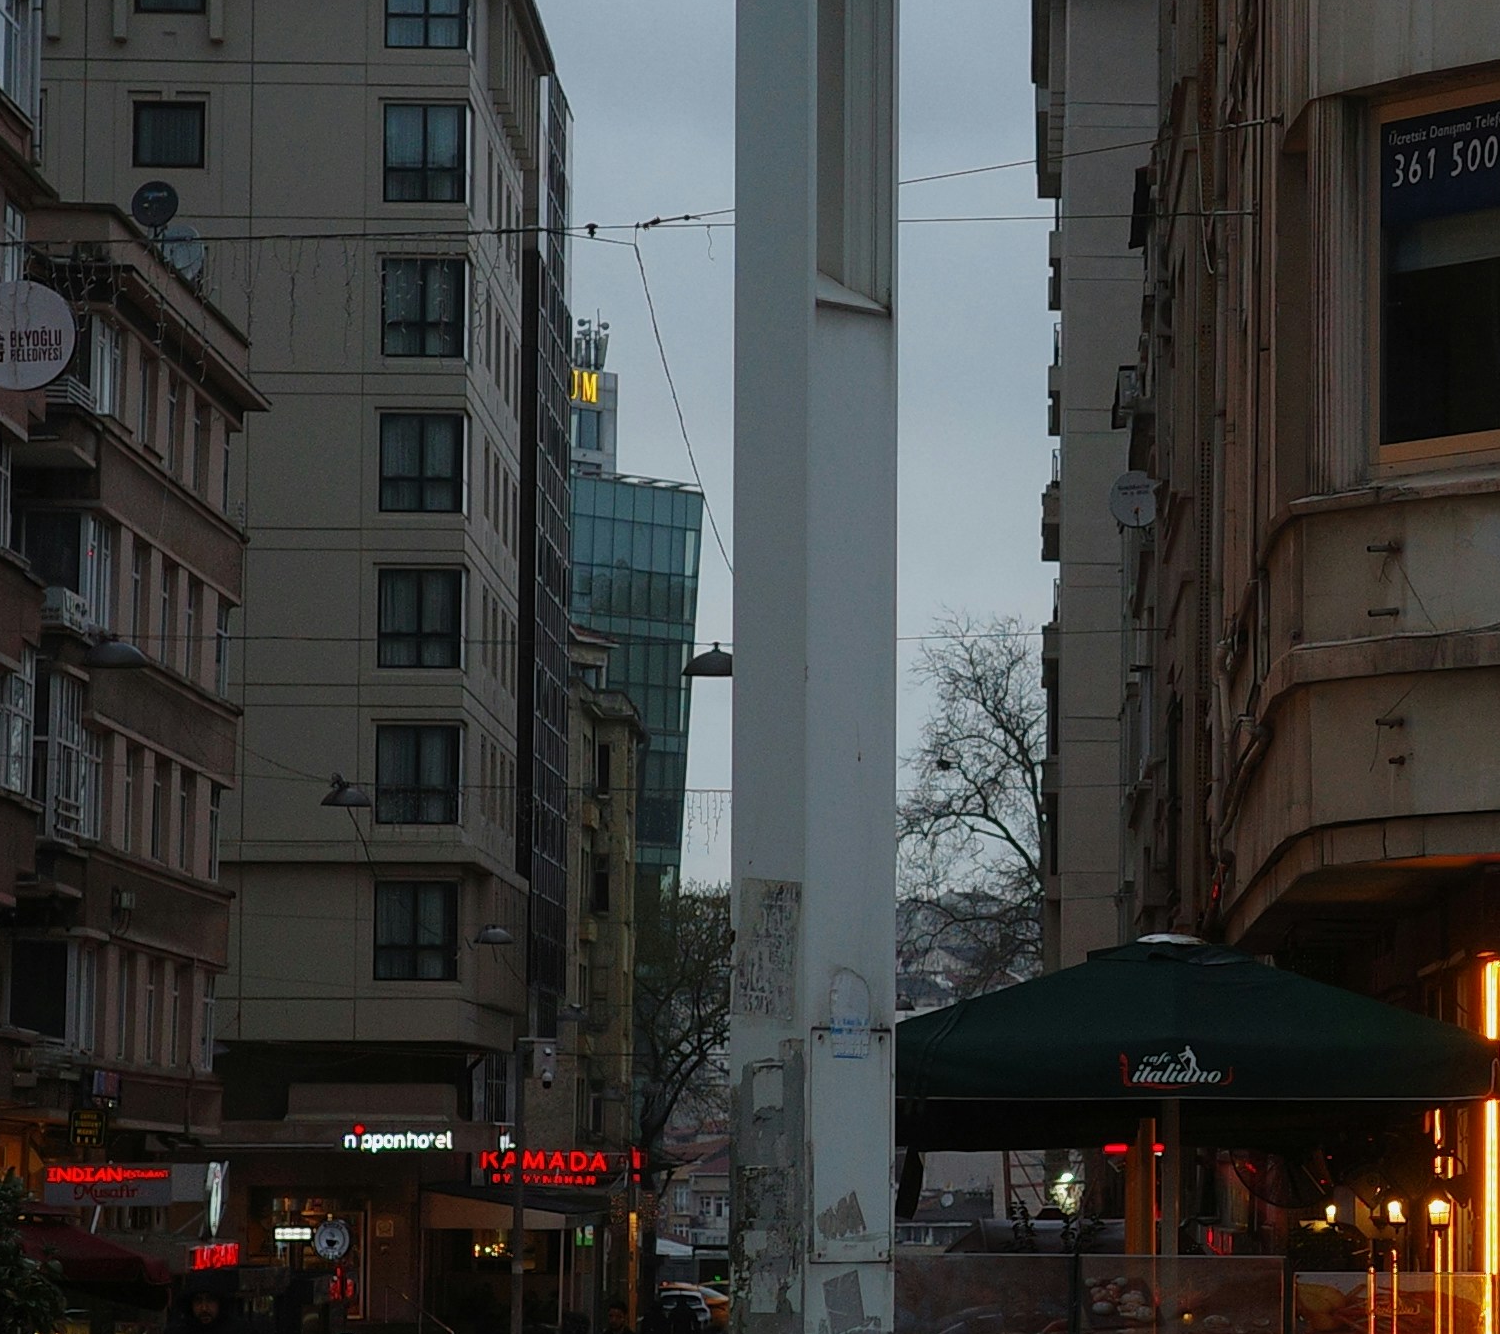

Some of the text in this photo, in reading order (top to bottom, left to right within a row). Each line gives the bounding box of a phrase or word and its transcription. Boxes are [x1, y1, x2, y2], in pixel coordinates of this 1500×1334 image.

[1391, 147, 1436, 187] 361
[10, 326, 62, 348] BEYOĞLU
[1142, 1051, 1172, 1066] cafe
[1132, 1063, 1222, 1083] italiano
[46, 1166, 122, 1183] INDIAN
